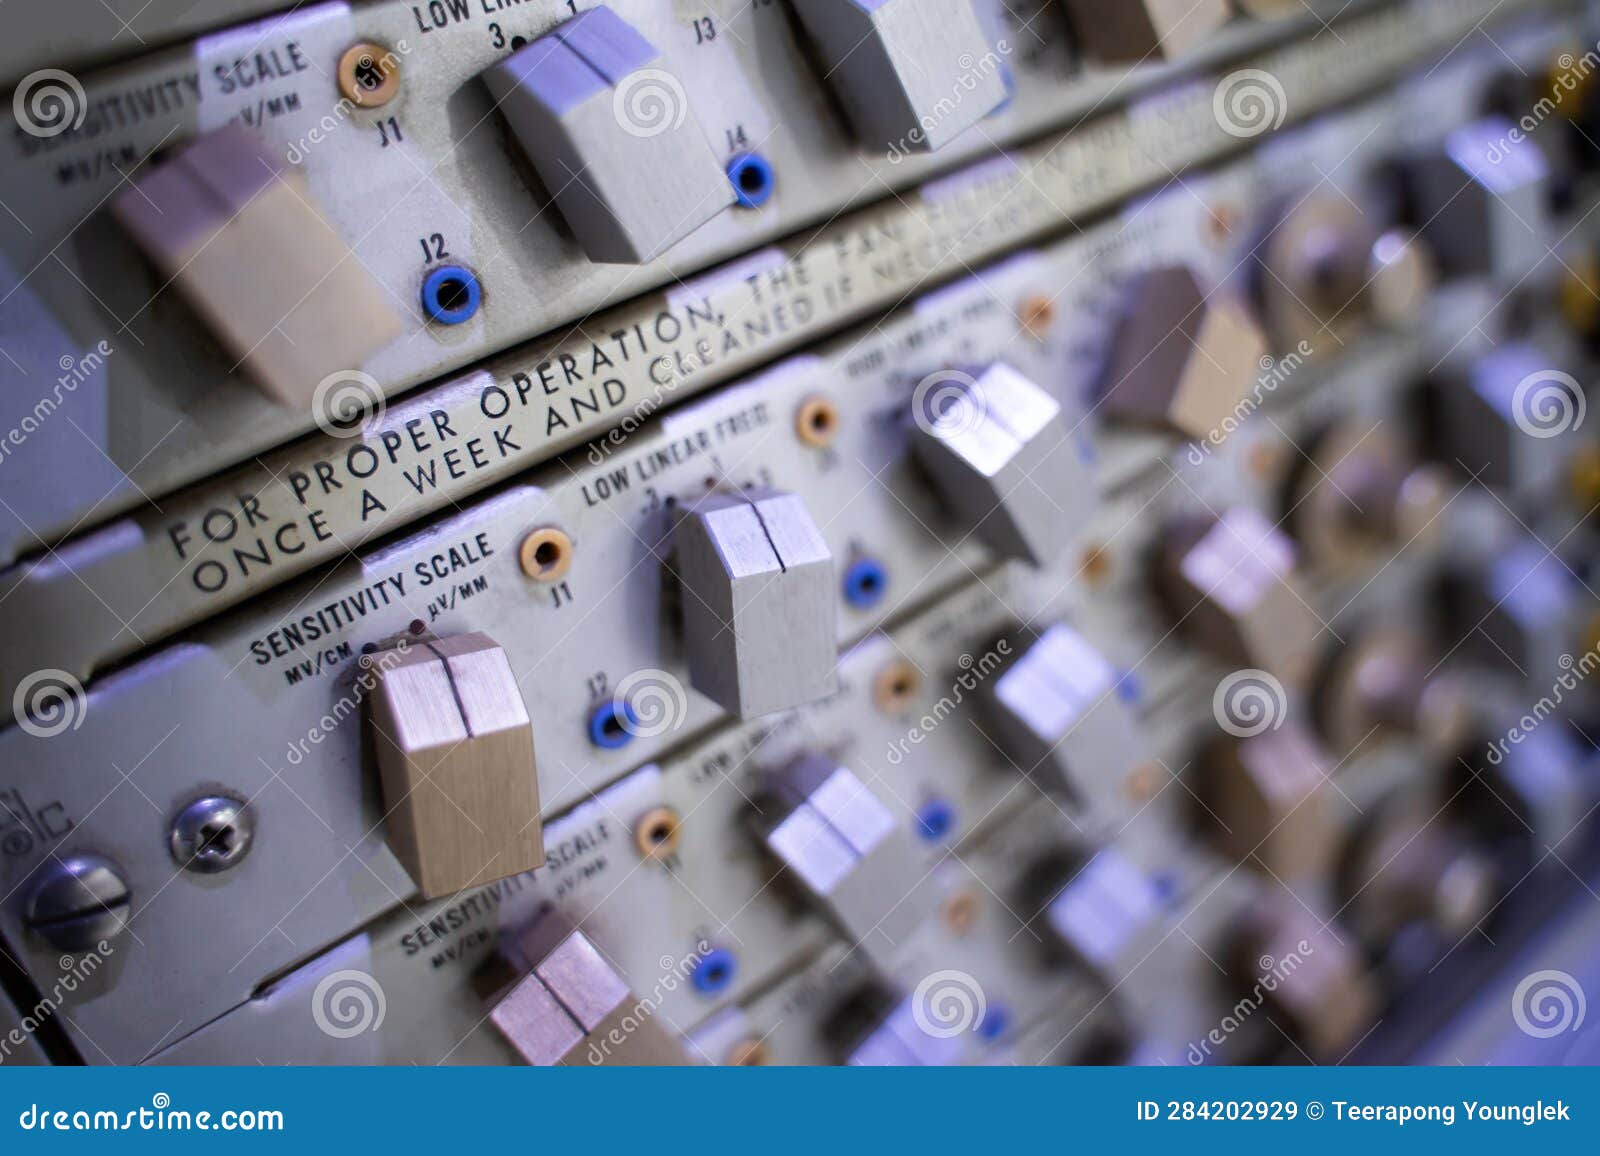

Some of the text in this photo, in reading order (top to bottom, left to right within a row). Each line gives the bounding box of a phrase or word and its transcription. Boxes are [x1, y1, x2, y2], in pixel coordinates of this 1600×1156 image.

[413, 0, 470, 33] LOW
[693, 16, 716, 45] J3
[488, 22, 505, 49] 3
[213, 42, 307, 95] SCALE
[229, 92, 302, 128] V/MM
[376, 117, 404, 147] J1
[726, 125, 747, 151] J4
[419, 232, 449, 264] J2
[167, 492, 270, 560] FOR
[288, 408, 457, 505] PROPER
[481, 296, 724, 419] OPERATION,
[745, 254, 809, 303] THE
[193, 509, 333, 593] ONCE
[362, 489, 387, 521] A
[403, 423, 521, 495] WEEK
[546, 377, 627, 436] AND
[648, 296, 814, 385] CLEANED
[582, 467, 629, 507] LOW
[636, 430, 708, 480] LINEAR
[250, 532, 495, 665] SENSITIVITY SCALE
[551, 582, 573, 608] J1
[284, 641, 353, 686] MV/CM
[545, 823, 610, 872] SCALE
